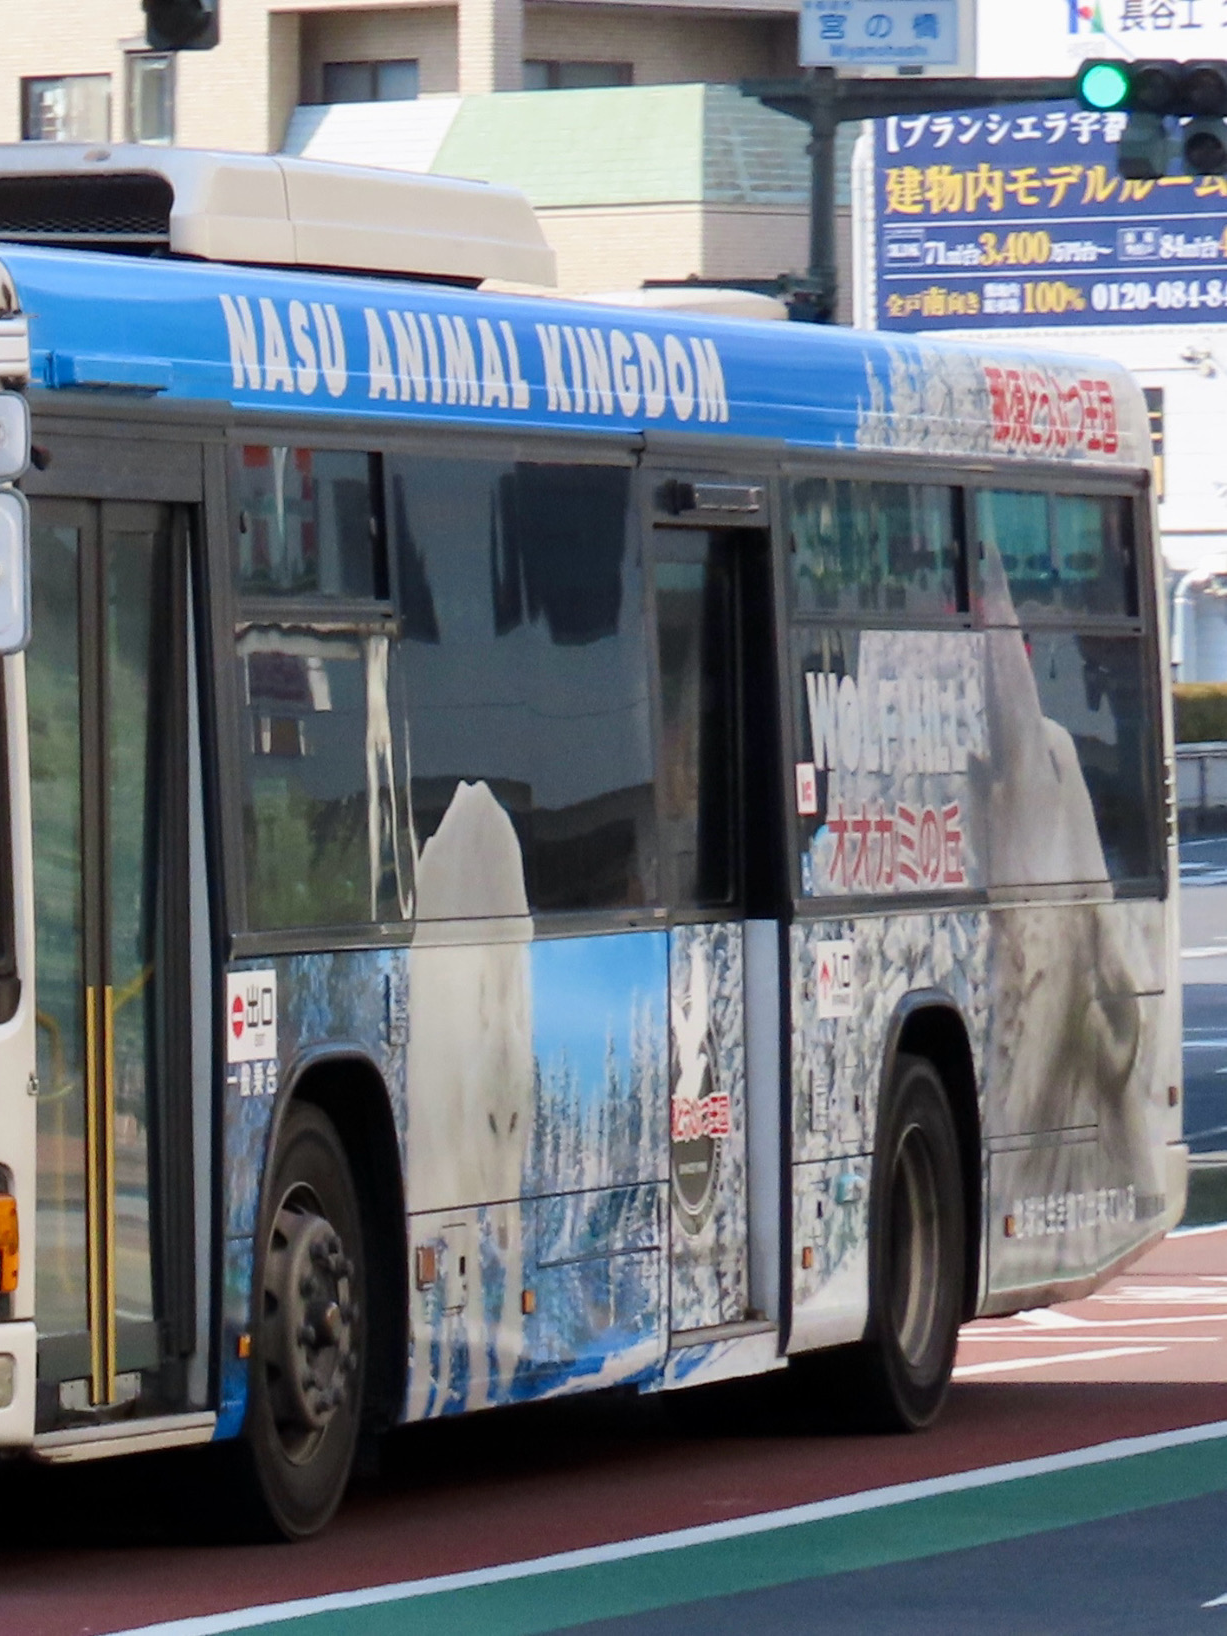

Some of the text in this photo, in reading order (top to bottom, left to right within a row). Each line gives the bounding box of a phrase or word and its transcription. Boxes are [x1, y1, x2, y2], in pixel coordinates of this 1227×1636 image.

[1120, 0, 1227, 31] 長谷工
[1023, 280, 1087, 315] 100%
[219, 293, 730, 423] NASU ANIMAL KINGDOM
[827, 803, 965, 888] オオカミの丘
[246, 984, 273, 1028] 出口
